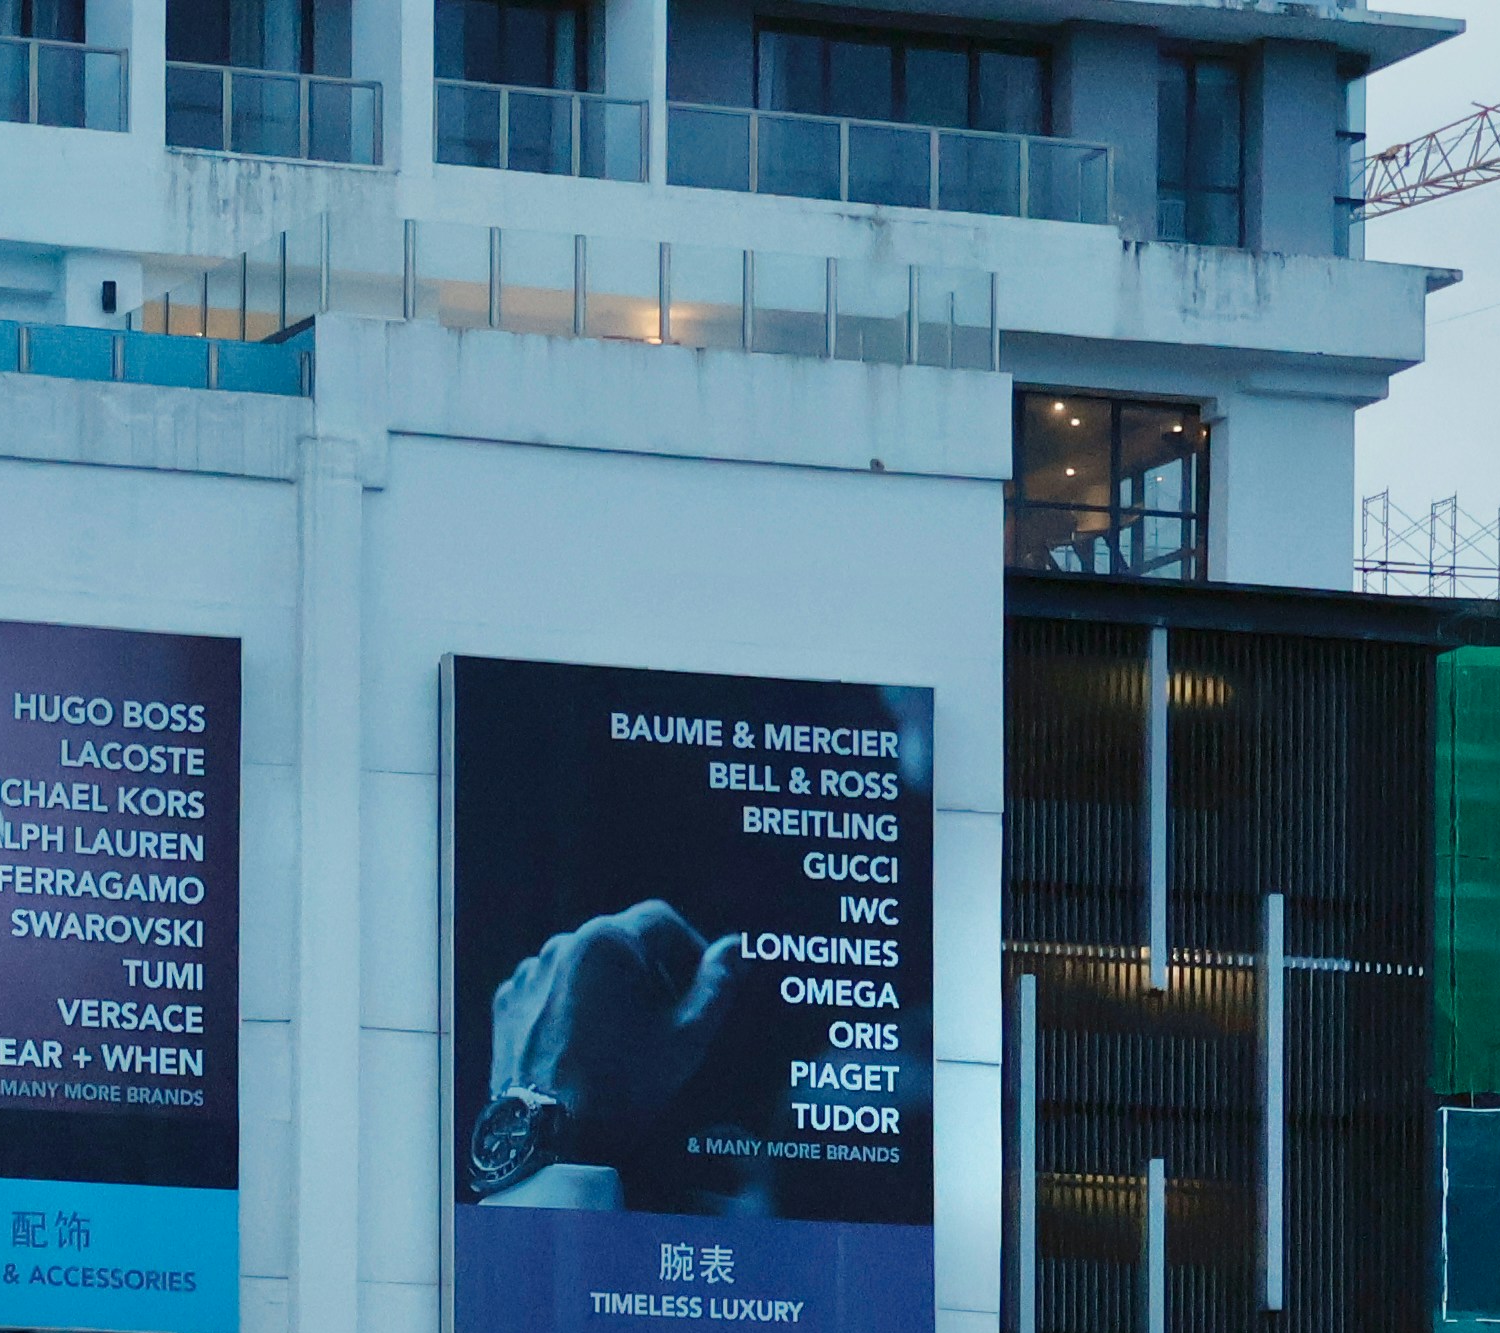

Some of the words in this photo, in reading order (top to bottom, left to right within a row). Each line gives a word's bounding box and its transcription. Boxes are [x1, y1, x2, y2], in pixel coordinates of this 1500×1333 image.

[13, 693, 113, 729] HUGO
[123, 702, 206, 733] BOSS
[611, 713, 723, 748] BAUME
[732, 721, 756, 749] &
[764, 724, 899, 758] MERCIER
[60, 739, 205, 777] LACOSTE
[709, 762, 780, 794] BELL
[788, 768, 812, 796] &
[820, 770, 899, 801] ROSS
[118, 788, 205, 819] KORS
[743, 806, 899, 842] BREITLING
[74, 829, 204, 862] LAUREN
[803, 851, 899, 884] GUCCI
[839, 896, 899, 926] IWC
[10, 910, 204, 948] SWAROVSKI
[740, 932, 899, 967] LONGINES
[123, 960, 204, 990] TUMI
[780, 976, 899, 1009] OMEGA
[58, 998, 204, 1034] VERSACE
[828, 1021, 899, 1050] ORIS
[72, 1048, 93, 1069] +
[100, 1044, 203, 1077] WHEN
[790, 1062, 900, 1092] PIAGET
[0, 1078, 59, 1100] MANY
[64, 1082, 121, 1103] MORE
[127, 1086, 204, 1108] BRANDS
[791, 1103, 900, 1134] TUDOR
[687, 1137, 701, 1154] &
[706, 1138, 761, 1159] MANY
[766, 1141, 821, 1161] MORE
[826, 1144, 900, 1164] BRANDS
[3, 1263, 20, 1284] &
[29, 1265, 197, 1292] ACCESSORIES
[659, 1243, 736, 1285] 腕表
[590, 1292, 704, 1318] TIMELESS
[709, 1297, 804, 1324] LUXURY
